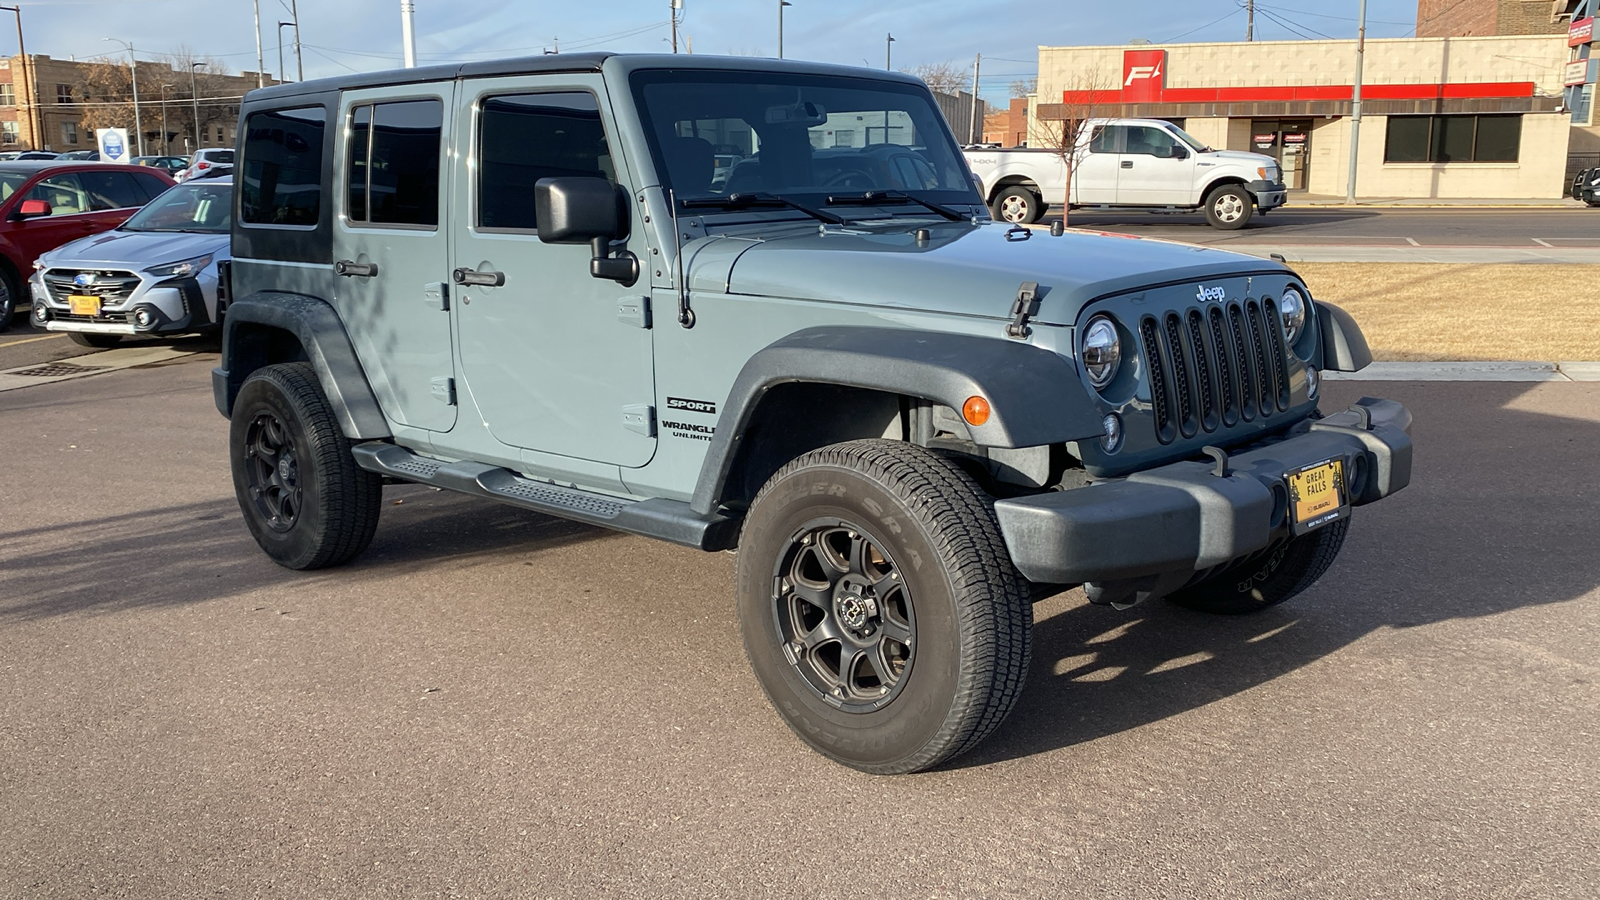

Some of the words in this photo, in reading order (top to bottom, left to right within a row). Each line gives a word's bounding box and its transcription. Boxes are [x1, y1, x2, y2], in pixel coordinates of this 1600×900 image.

[1196, 285, 1225, 302] Jeep
[670, 400, 715, 411] SPORT
[662, 420, 716, 434] WRANGL
[673, 432, 712, 441] UNLIMIT
[1306, 470, 1325, 484] GREAT
[1307, 481, 1327, 496] FALLS
